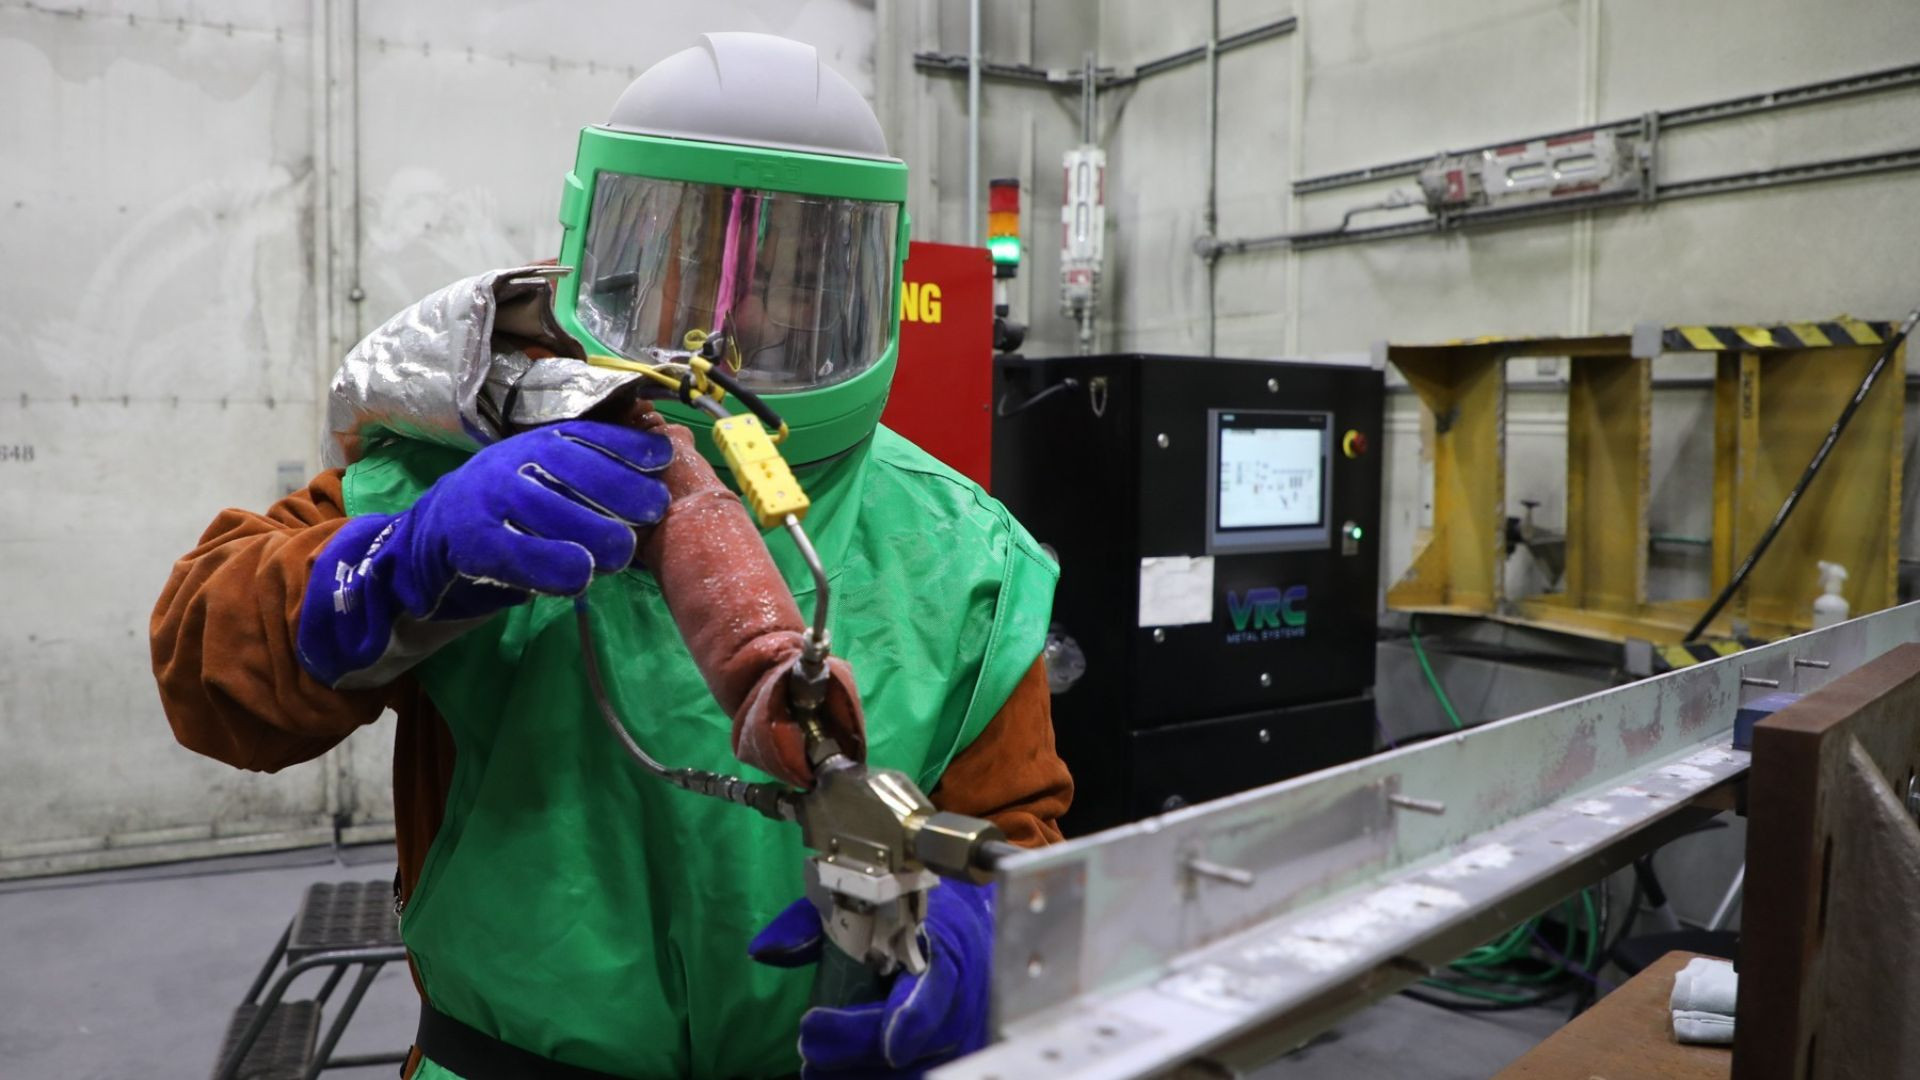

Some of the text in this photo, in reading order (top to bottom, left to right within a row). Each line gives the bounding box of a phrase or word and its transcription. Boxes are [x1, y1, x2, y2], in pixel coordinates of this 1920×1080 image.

[1227, 585, 1308, 631] VRC
[1226, 626, 1306, 643] METAL SYSTEMS
